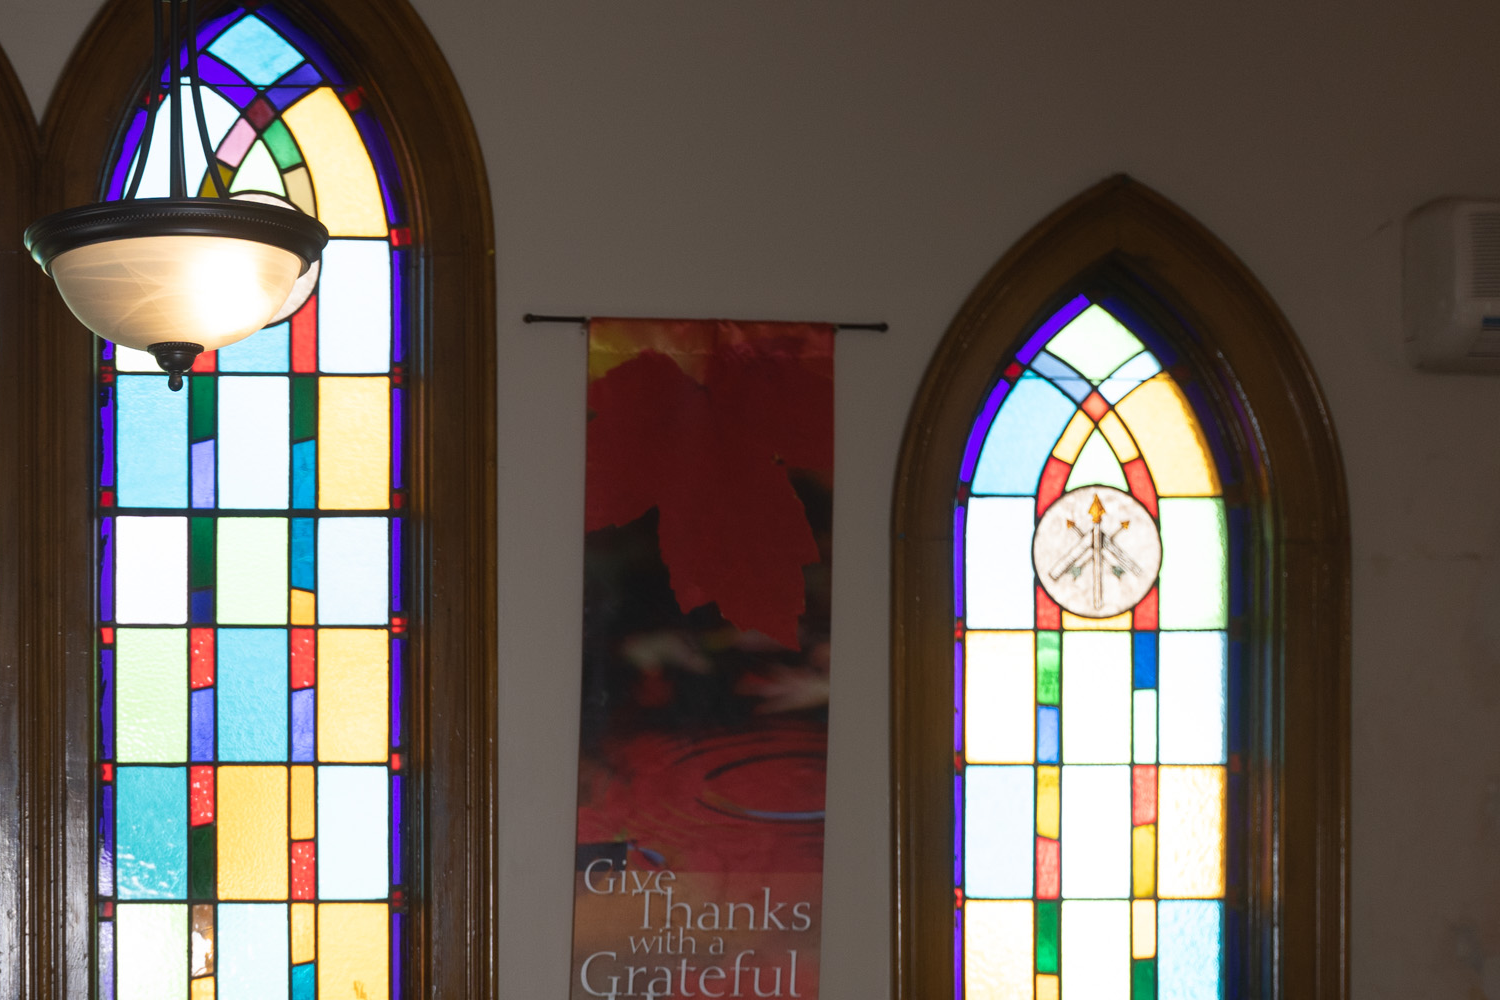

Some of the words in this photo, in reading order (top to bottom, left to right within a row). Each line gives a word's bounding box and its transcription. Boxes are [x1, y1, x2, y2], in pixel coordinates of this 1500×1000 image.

[584, 858, 676, 895] Give
[632, 886, 812, 931] Thanks
[629, 927, 696, 955] with
[709, 936, 725, 955] a
[580, 950, 801, 998] Grateful
